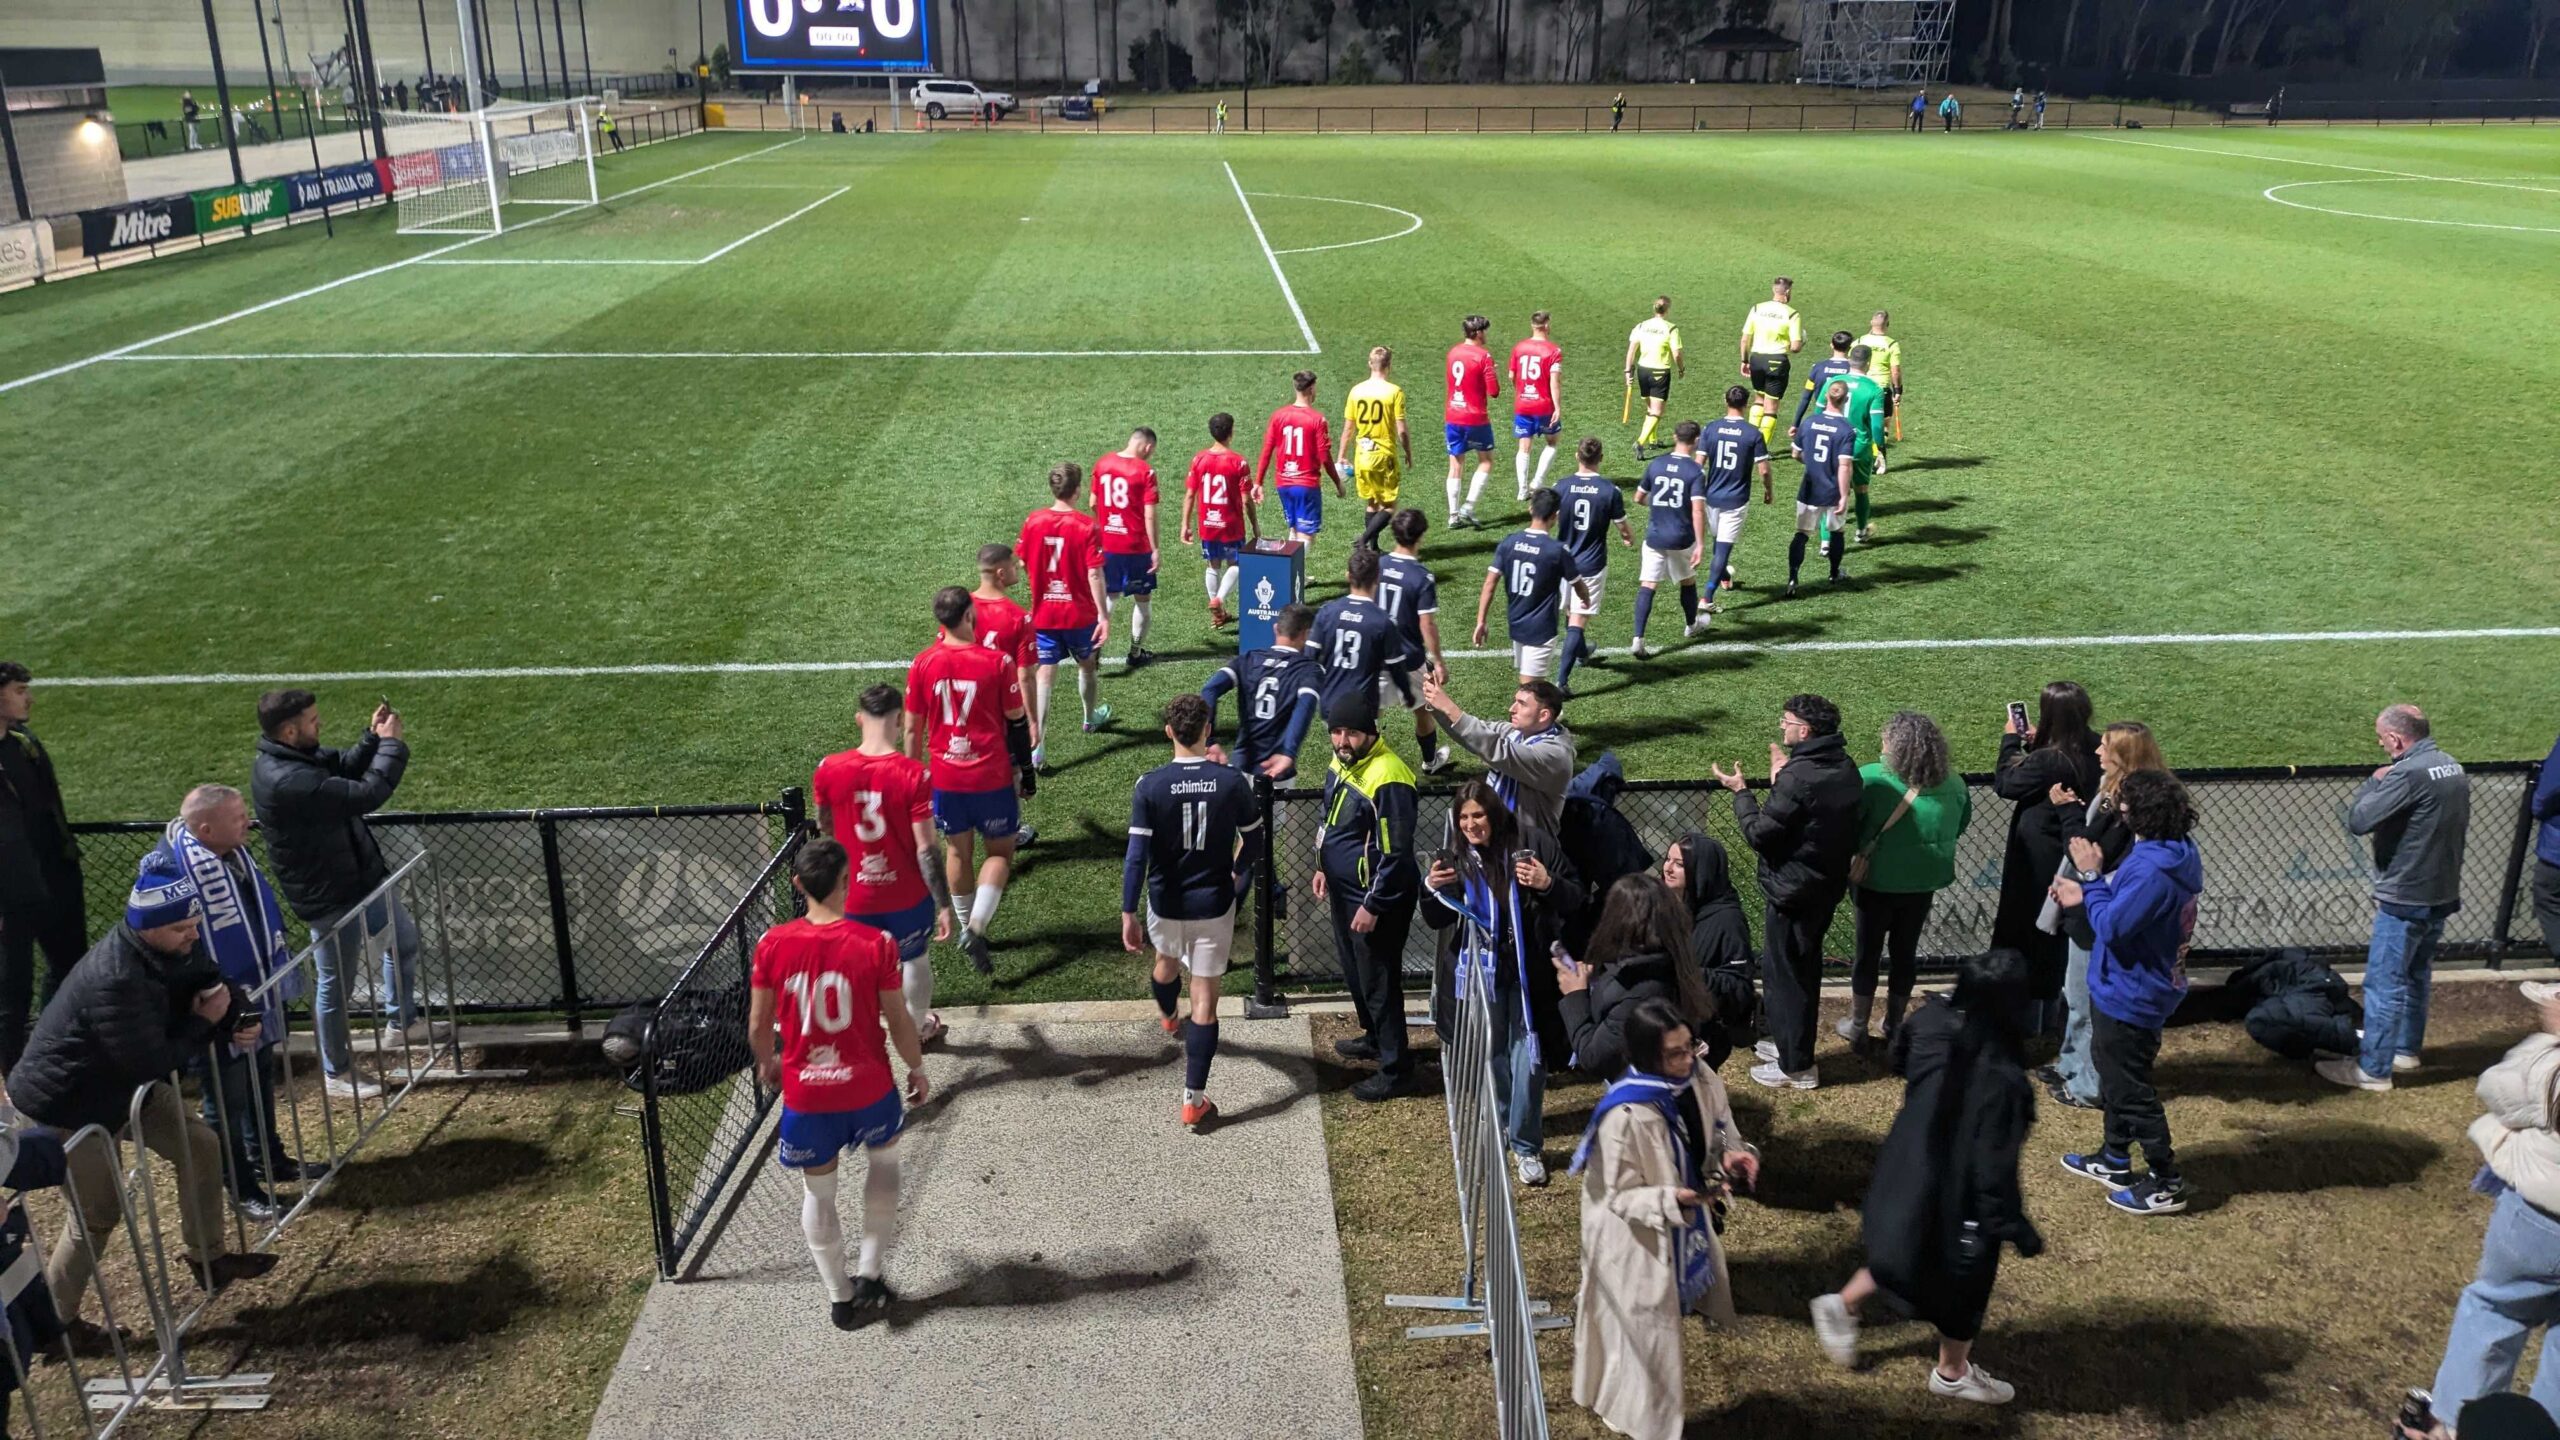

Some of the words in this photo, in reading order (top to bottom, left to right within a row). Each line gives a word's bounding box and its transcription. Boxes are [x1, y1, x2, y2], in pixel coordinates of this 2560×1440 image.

[358, 173, 374, 190] CUP
[110, 209, 172, 247] Mitre
[1451, 360, 1465, 387] 9
[1519, 355, 1541, 381] 15
[1357, 400, 1384, 424] 20
[1282, 425, 1303, 457] 11
[1716, 440, 1738, 470] 15
[1814, 434, 1829, 462] 5
[1100, 474, 1129, 509] 18
[1202, 472, 1228, 504] 12
[1652, 476, 1684, 508] 23
[1574, 499, 1590, 530] 9
[1044, 536, 1064, 572] 7
[1511, 559, 1537, 597] 16
[1043, 593, 1072, 601] PRIME
[1379, 582, 1401, 624] 17
[1333, 628, 1362, 669] 13
[934, 678, 977, 727] 17
[1255, 677, 1279, 719] 6
[1170, 778, 1217, 795] schimizzi
[854, 791, 886, 842] 3
[1182, 801, 1207, 850] 11
[784, 970, 852, 1036] 10
